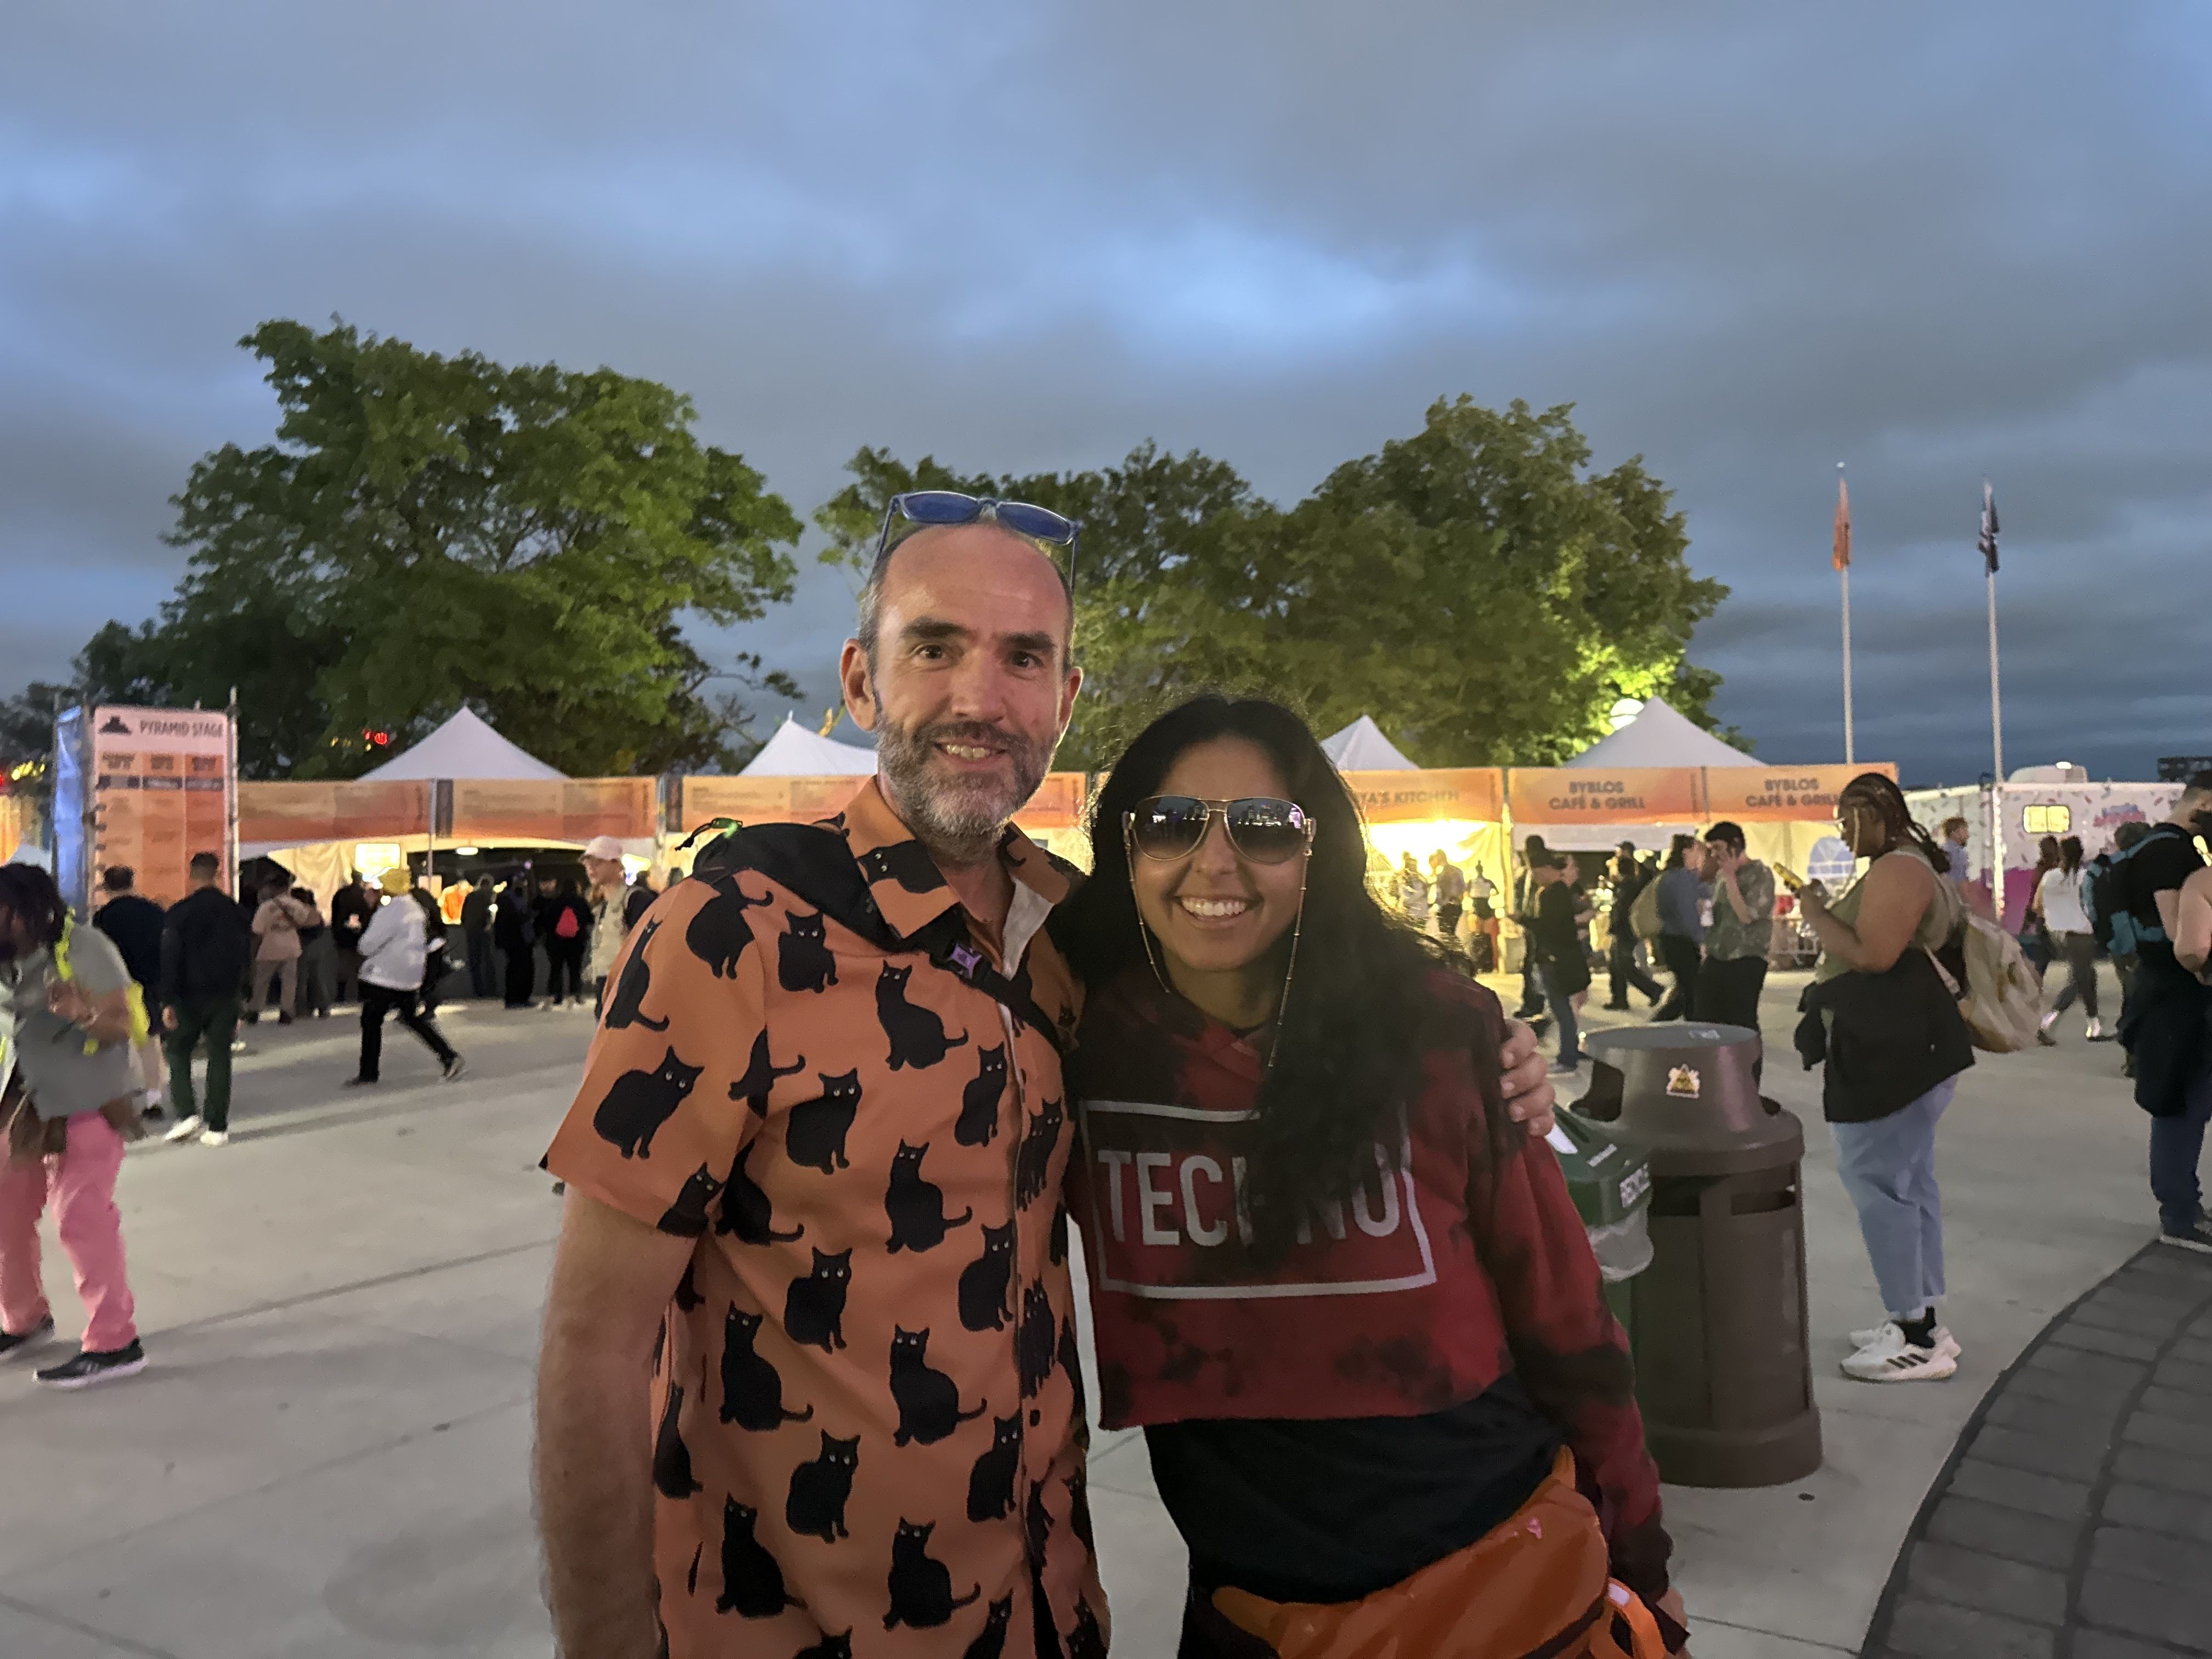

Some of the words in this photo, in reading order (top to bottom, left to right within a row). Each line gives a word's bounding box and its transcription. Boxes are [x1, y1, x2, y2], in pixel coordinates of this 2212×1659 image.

[140, 720, 190, 737] PYRAMID
[192, 722, 223, 738] STAGE
[1569, 781, 1624, 794] BYBLOS
[1765, 778, 1819, 791] BYBLOS
[1590, 798, 1601, 809] &
[1605, 797, 1645, 810] GRILL
[1786, 795, 1797, 806] &
